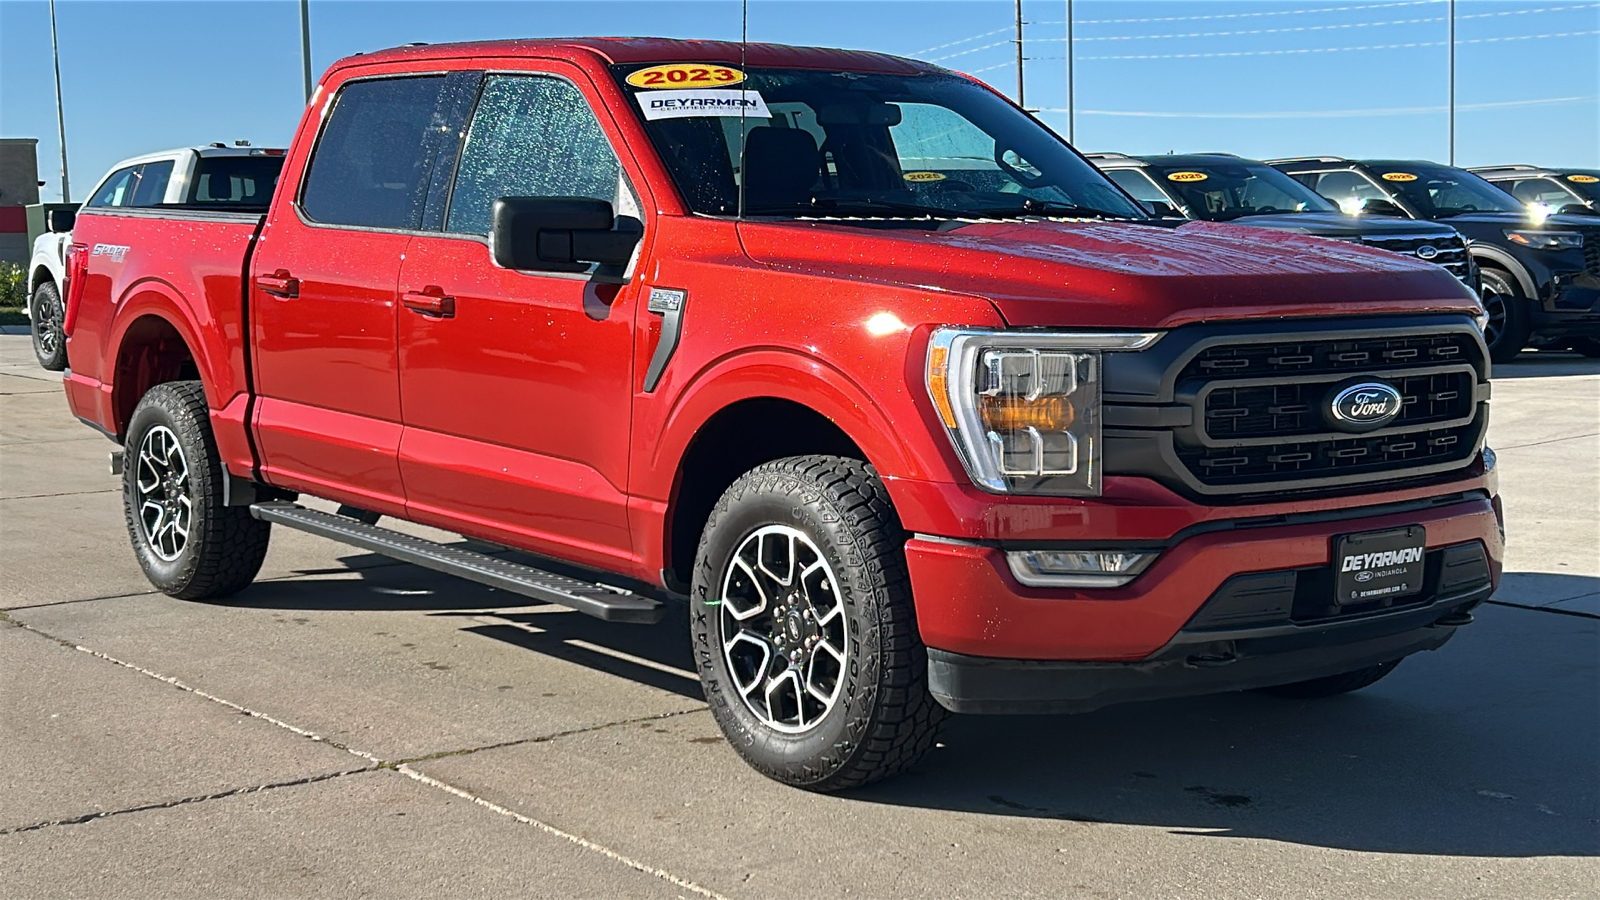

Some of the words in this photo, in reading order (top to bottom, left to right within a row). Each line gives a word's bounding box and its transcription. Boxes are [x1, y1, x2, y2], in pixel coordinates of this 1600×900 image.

[643, 69, 736, 85] 2023
[651, 98, 757, 108] DEYARMAN
[92, 243, 131, 256] SPORT
[1351, 392, 1388, 416] Ford
[1341, 546, 1423, 573] DEYARMAN
[698, 554, 713, 601] A/T
[1374, 567, 1408, 578] INDIANOLA
[696, 609, 714, 671] MAX
[843, 617, 861, 715] SPORT
